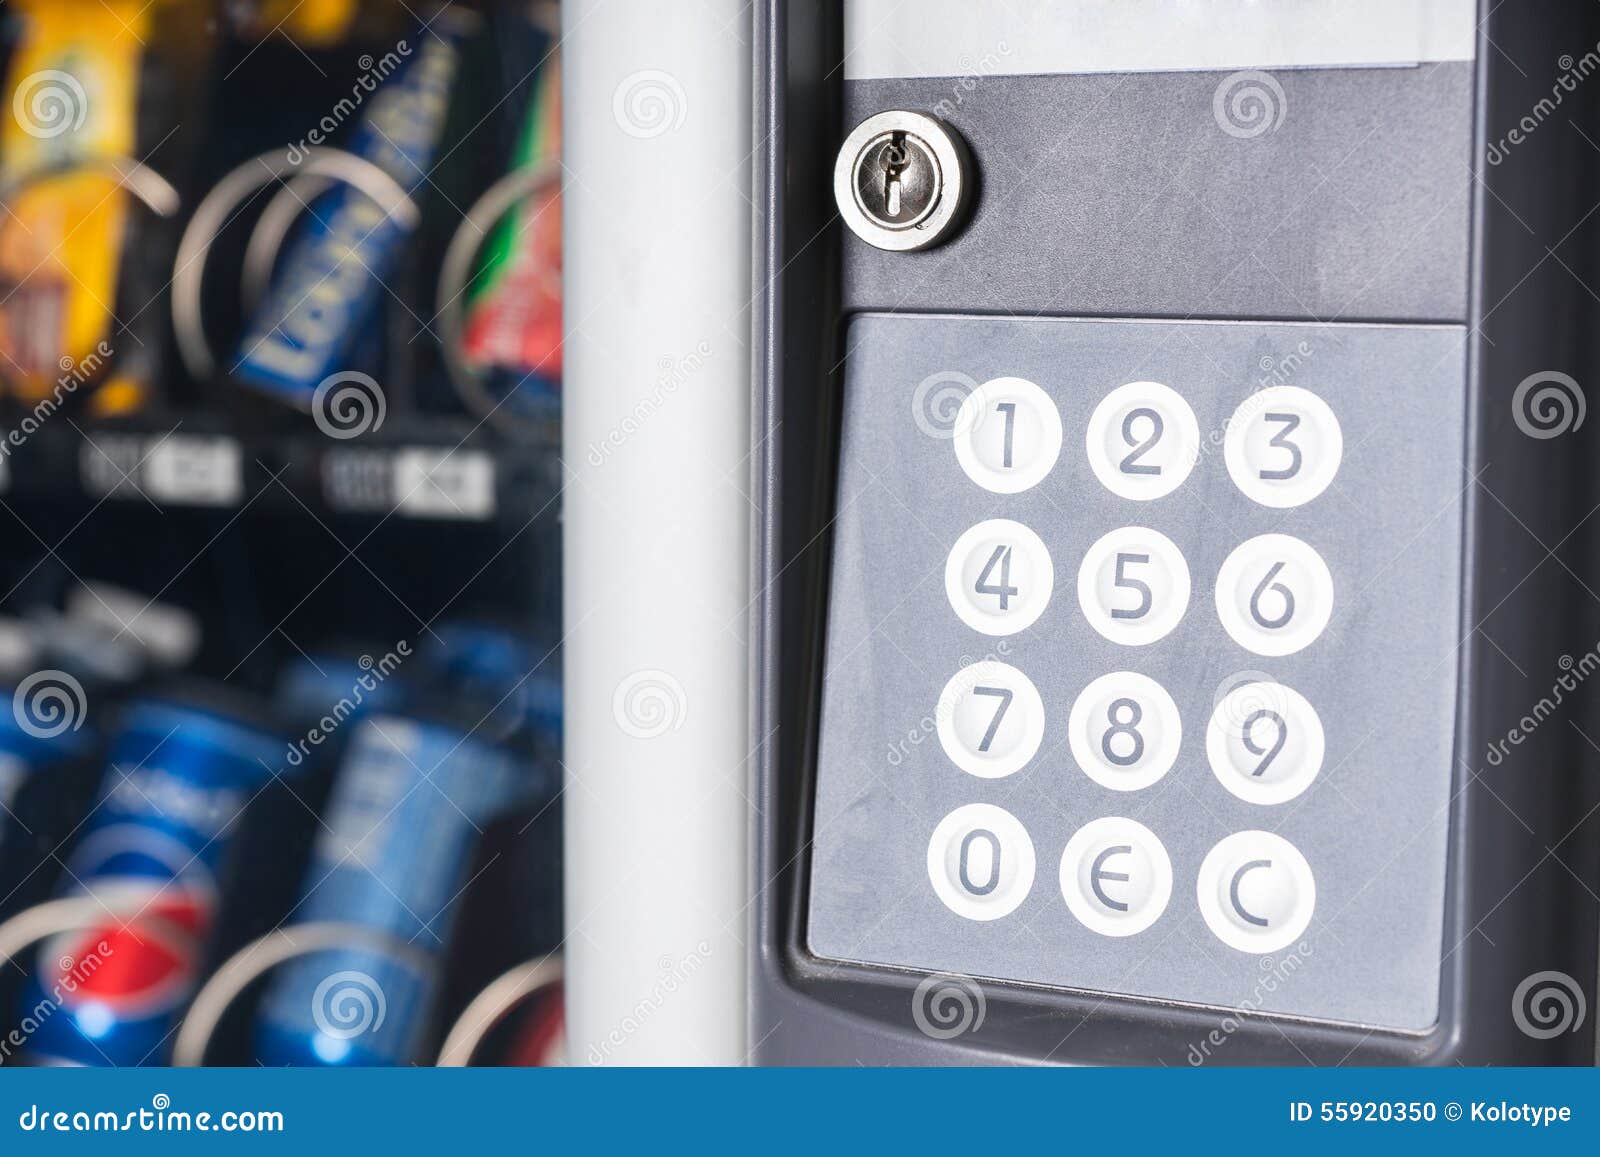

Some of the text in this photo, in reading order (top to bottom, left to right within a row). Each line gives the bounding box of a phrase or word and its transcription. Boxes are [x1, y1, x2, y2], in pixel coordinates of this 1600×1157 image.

[995, 402, 1302, 480] 1 2 3
[974, 545, 1295, 630] 4 5 6
[973, 686, 1287, 777] 7 8 9
[1229, 860, 1272, 927] C
